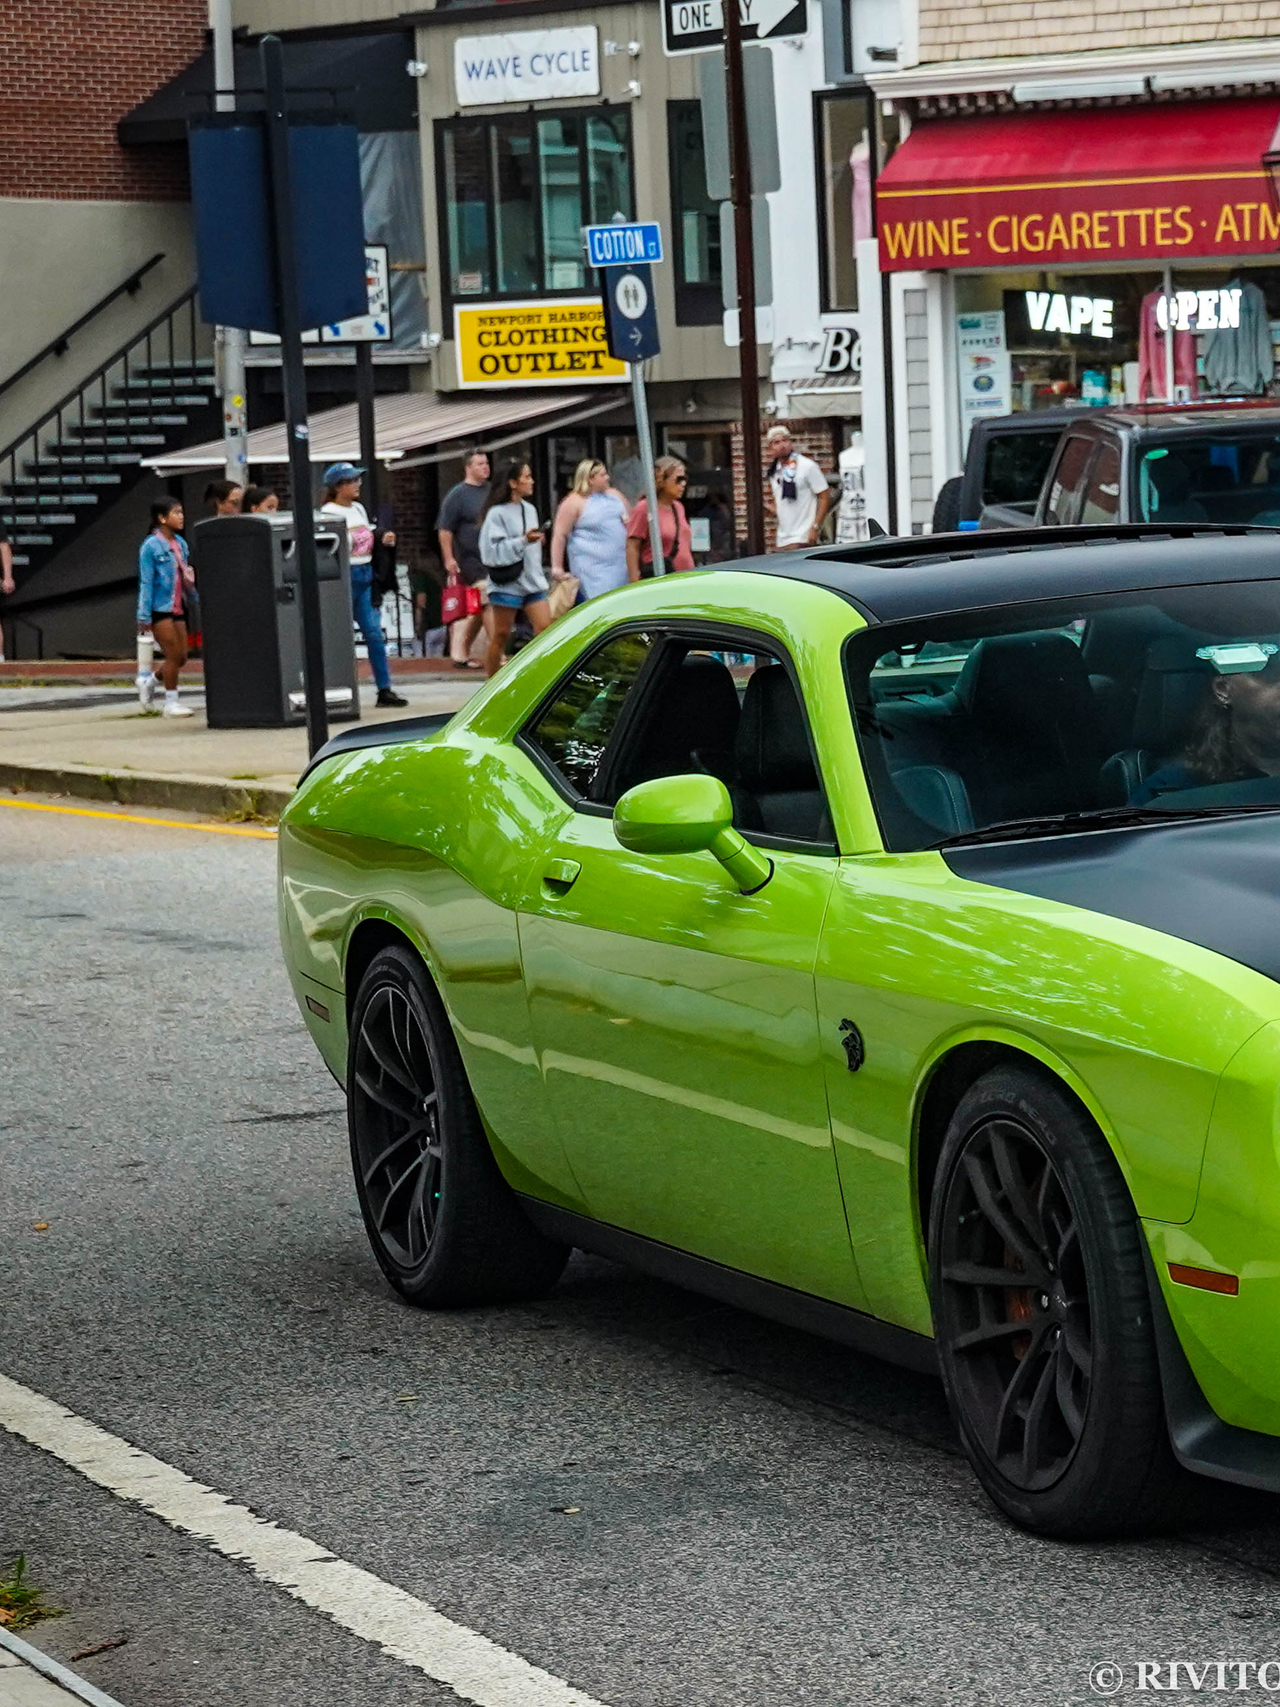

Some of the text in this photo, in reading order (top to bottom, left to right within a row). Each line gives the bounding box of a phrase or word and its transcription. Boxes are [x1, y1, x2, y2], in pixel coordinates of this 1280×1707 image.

[679, 3, 713, 31] ONE
[464, 49, 590, 80] WAVE CYCLE
[594, 229, 645, 261] COTTON
[883, 217, 971, 260] WINE
[987, 205, 1195, 254] CIGARETTES
[478, 313, 542, 327] NEWPORT
[1025, 291, 1114, 339] VAPE
[1156, 289, 1243, 331] OPEN
[477, 326, 606, 348] CLOTHING
[479, 350, 607, 375] OUTLET
